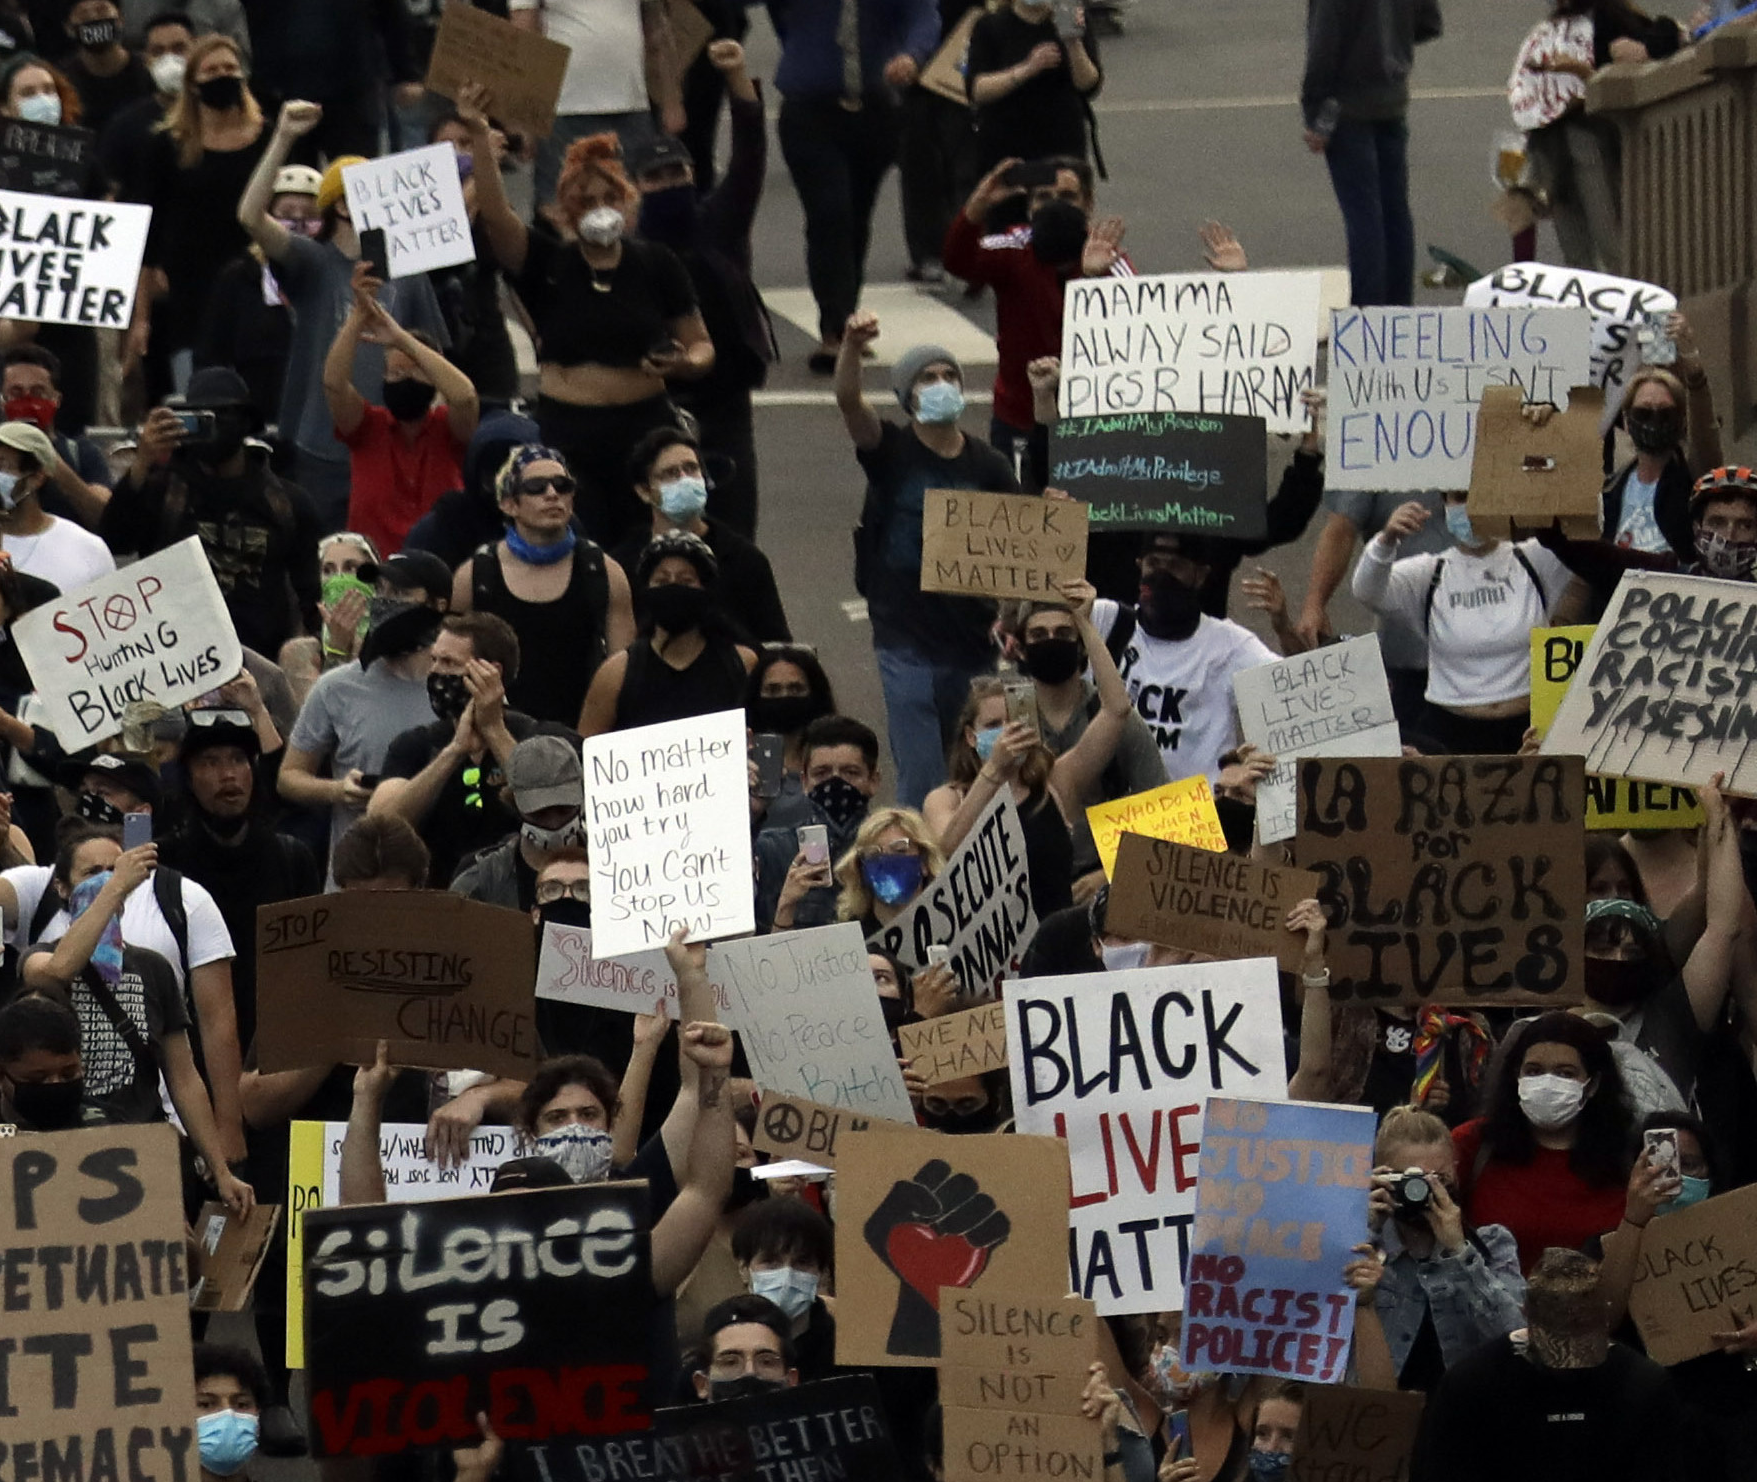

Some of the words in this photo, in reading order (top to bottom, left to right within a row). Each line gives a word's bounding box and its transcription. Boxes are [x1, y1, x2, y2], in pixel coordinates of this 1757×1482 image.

[353, 160, 432, 200] BLACK
[1074, 281, 1234, 318] MAMMA
[1071, 324, 1186, 364] ALWAY
[1199, 324, 1292, 357] SAID
[1332, 314, 1549, 363] KNEELING
[1197, 367, 1313, 419] HARAM
[1052, 454, 1225, 488] #IAdmitMyPrivilege
[943, 499, 1061, 532] BLACK
[967, 530, 1040, 561] LIVES
[934, 561, 1061, 592] MATTER
[1270, 651, 1355, 689] BLACK
[592, 752, 632, 784] No
[640, 739, 733, 776] matter
[591, 794, 644, 824] how
[654, 776, 715, 807] hard
[1303, 760, 1367, 835] LA
[1394, 758, 1567, 835] RAZA
[1148, 880, 1280, 933] VIOLENCE
[328, 952, 473, 985] RESISTING
[398, 1001, 532, 1057] CHANGE
[1019, 990, 1262, 1106] BLACK
[1186, 1292, 1349, 1331] RACIST
[1185, 1326, 1345, 1376] POLICE!
[979, 1374, 1057, 1403] NOT
[748, 1405, 884, 1462] BETTER
[1007, 1415, 1040, 1437] AN
